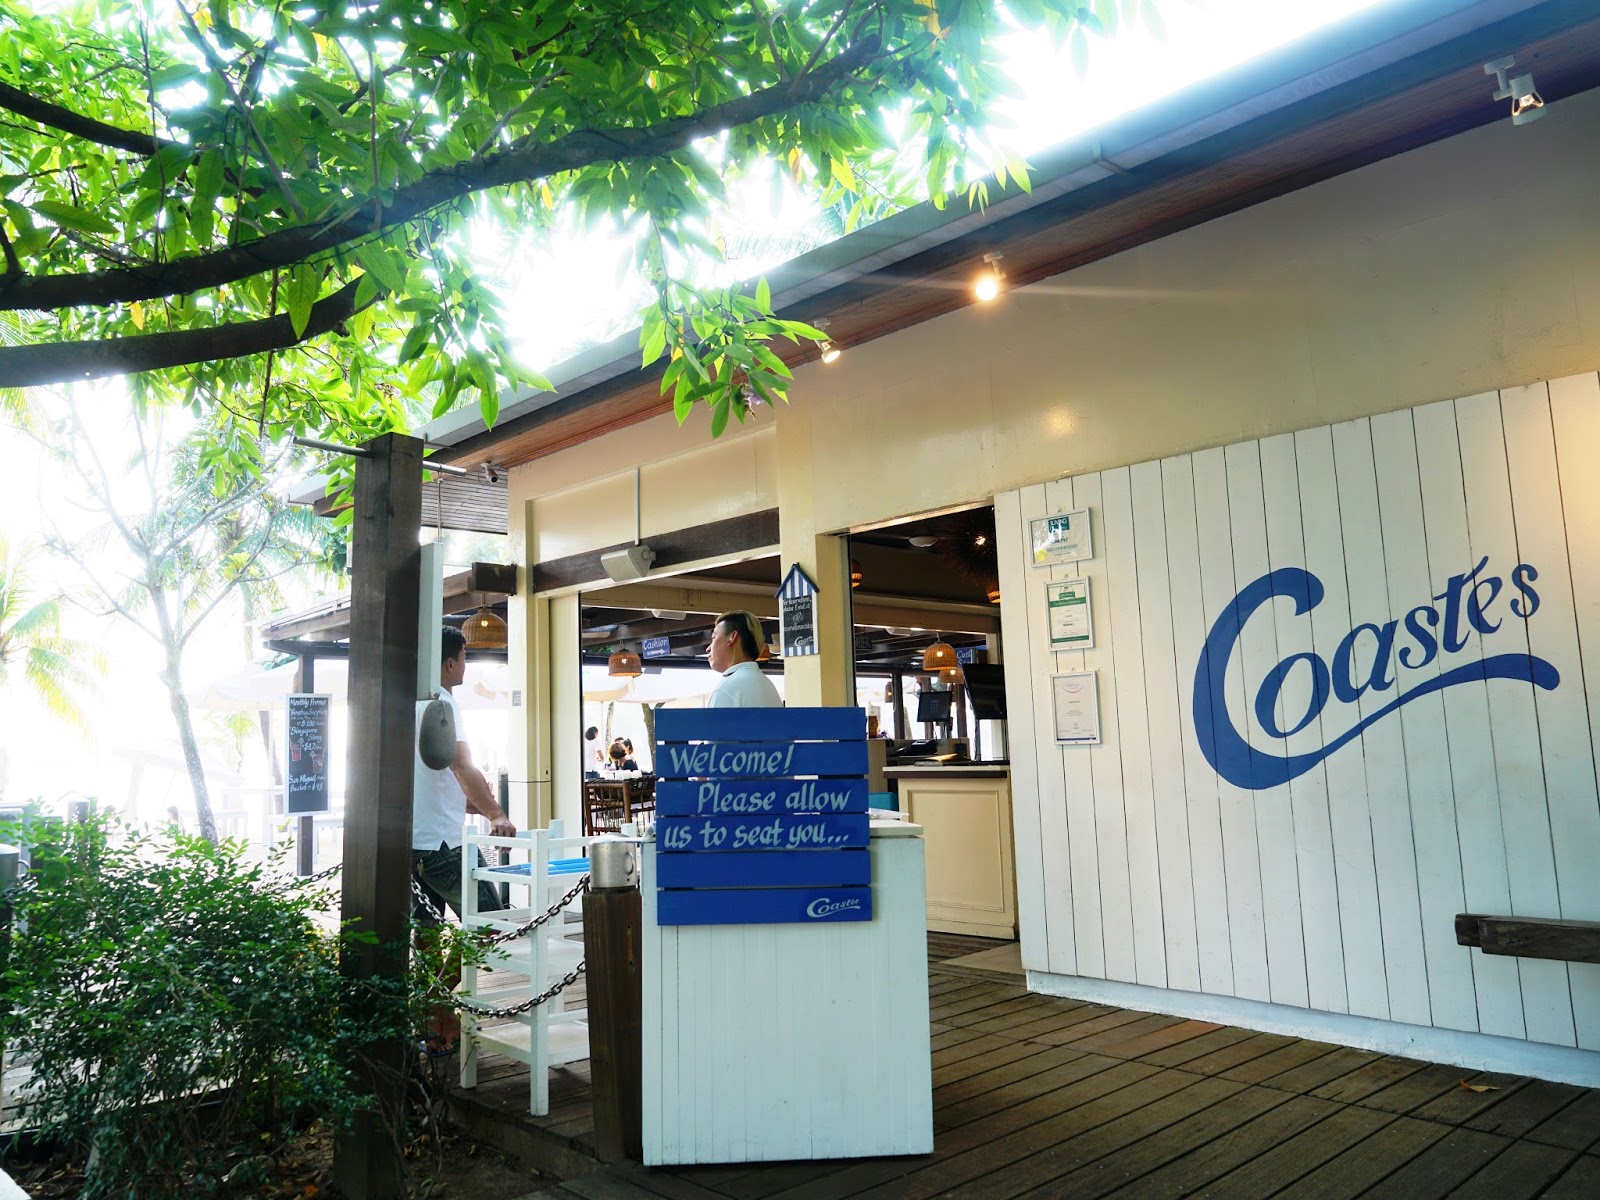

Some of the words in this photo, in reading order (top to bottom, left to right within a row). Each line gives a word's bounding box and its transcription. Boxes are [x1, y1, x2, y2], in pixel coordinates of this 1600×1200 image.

[670, 743, 795, 774] Welcome!
[697, 782, 776, 814] Please
[785, 782, 852, 811] allow
[664, 825, 692, 848] us
[700, 820, 727, 848] to
[733, 818, 784, 848] seat
[786, 822, 849, 849] you...
